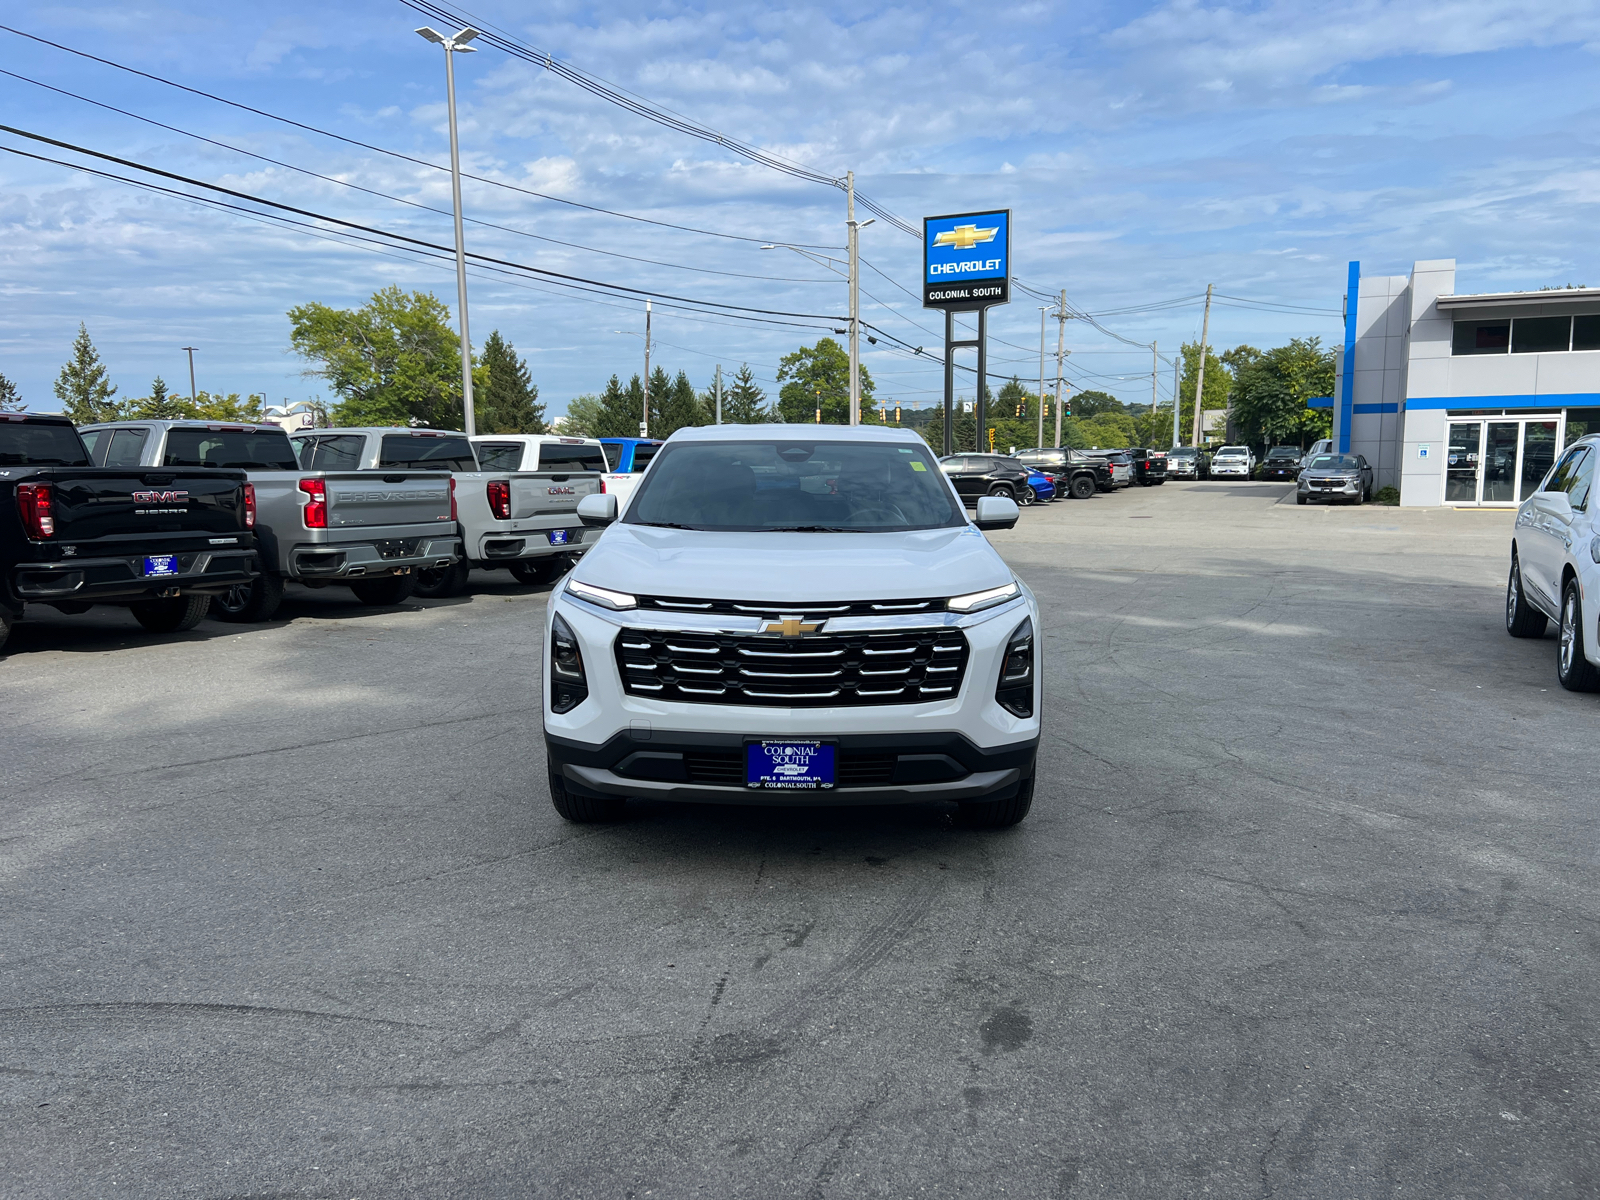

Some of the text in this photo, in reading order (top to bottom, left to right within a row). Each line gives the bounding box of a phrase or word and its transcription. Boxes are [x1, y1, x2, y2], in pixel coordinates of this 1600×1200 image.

[930, 259, 1001, 274] CHEVROLET
[929, 287, 1001, 300] COLONIAL SOUTH
[133, 490, 190, 503] GMC
[338, 490, 447, 502] CHEVROLET
[547, 486, 575, 495] GMC
[764, 746, 818, 755] COLONIAL
[772, 756, 809, 764] SOUTH
